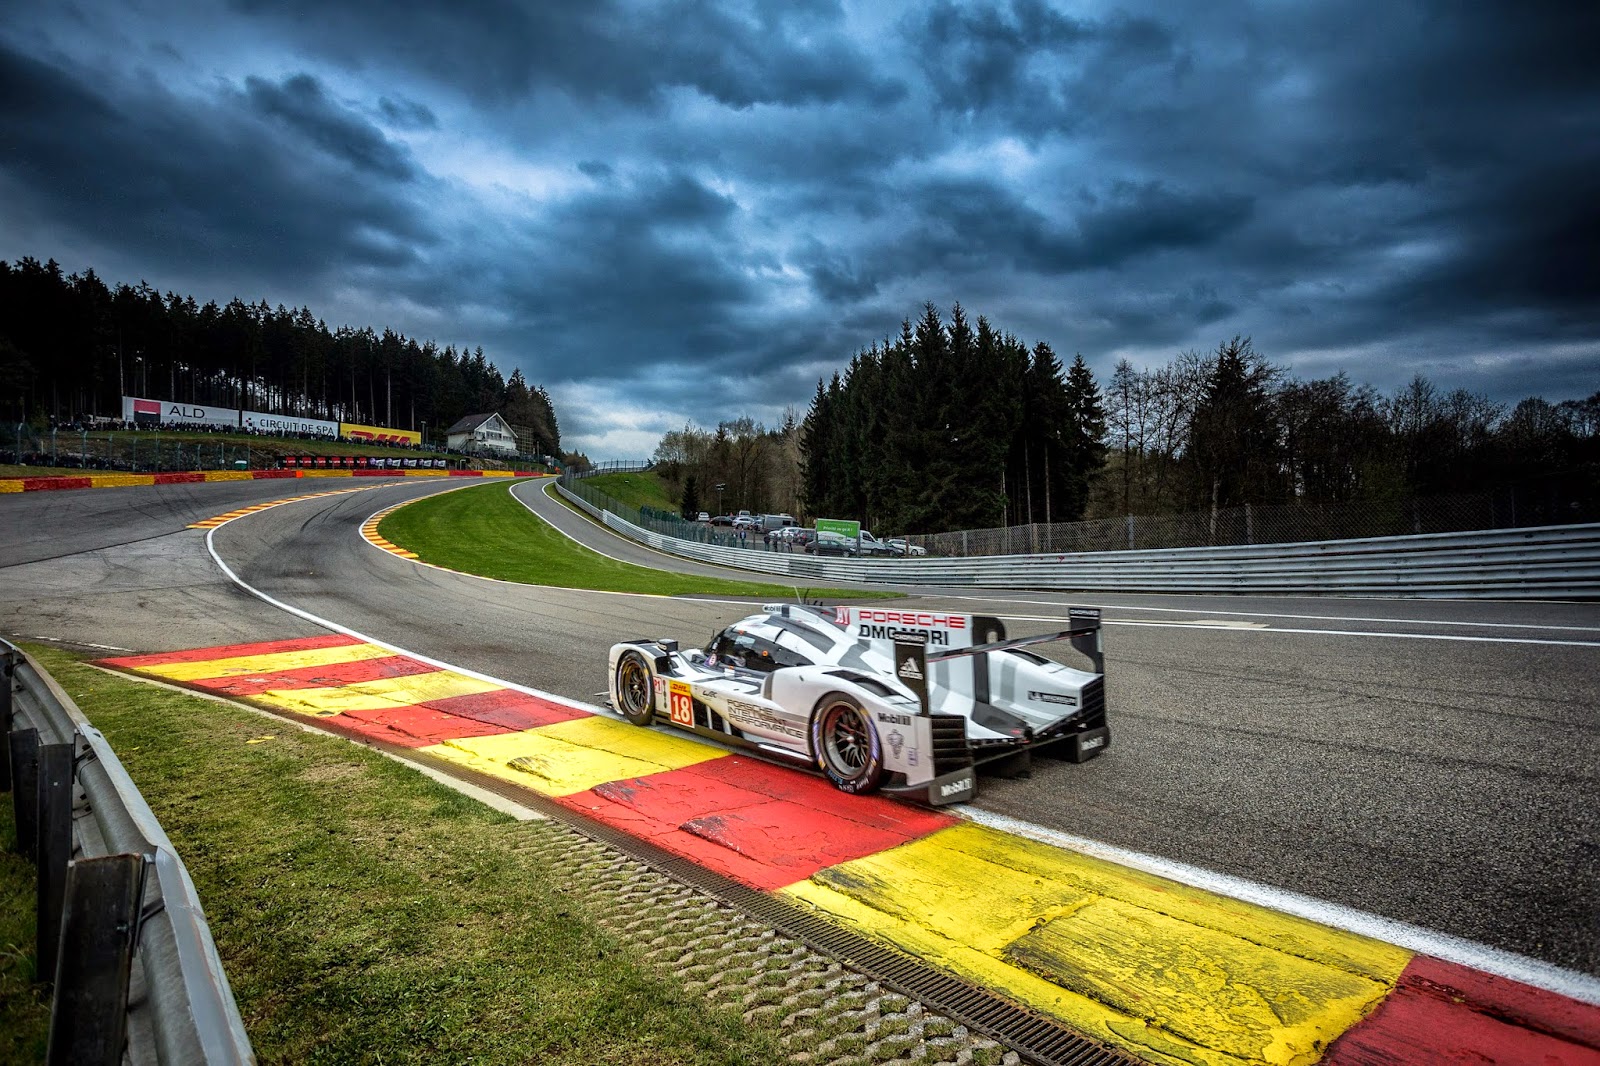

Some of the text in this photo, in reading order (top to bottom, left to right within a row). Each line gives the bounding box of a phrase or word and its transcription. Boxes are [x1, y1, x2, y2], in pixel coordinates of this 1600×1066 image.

[169, 406, 205, 419] ALD
[259, 418, 335, 436] CIRCUIT DE SPA
[858, 610, 966, 629] PORSCHE
[672, 683, 688, 693] DHL
[672, 695, 691, 723] 18
[727, 698, 773, 716] PORSCHE
[728, 712, 804, 739] PERFORMANCE
